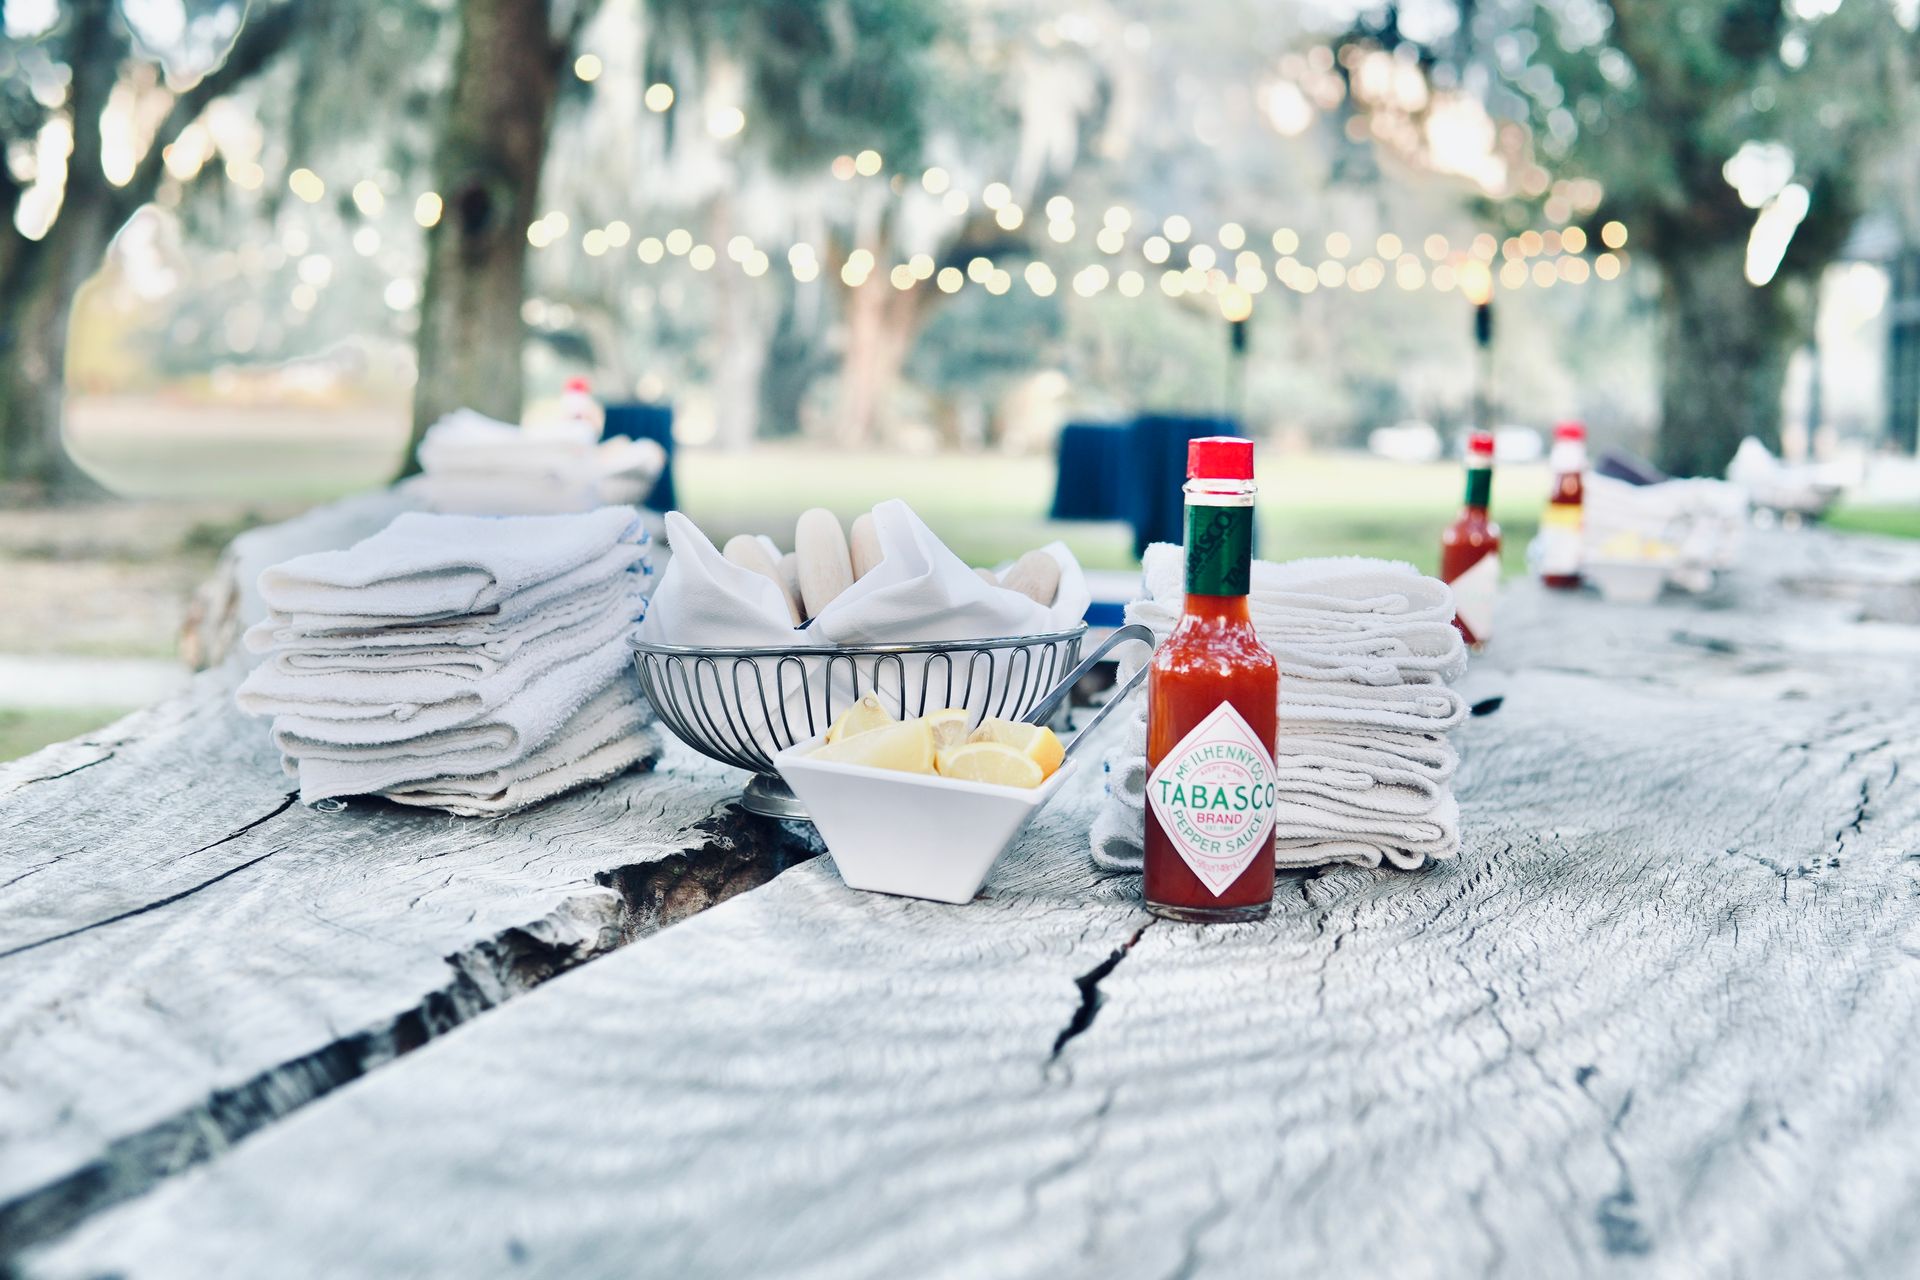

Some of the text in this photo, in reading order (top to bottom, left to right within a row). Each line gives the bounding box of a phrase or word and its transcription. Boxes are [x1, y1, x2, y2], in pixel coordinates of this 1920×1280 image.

[1158, 779, 1275, 811] TABASCO
[1173, 810, 1265, 854] PEPPER SAUCE
[1196, 812, 1243, 824] BRAND
